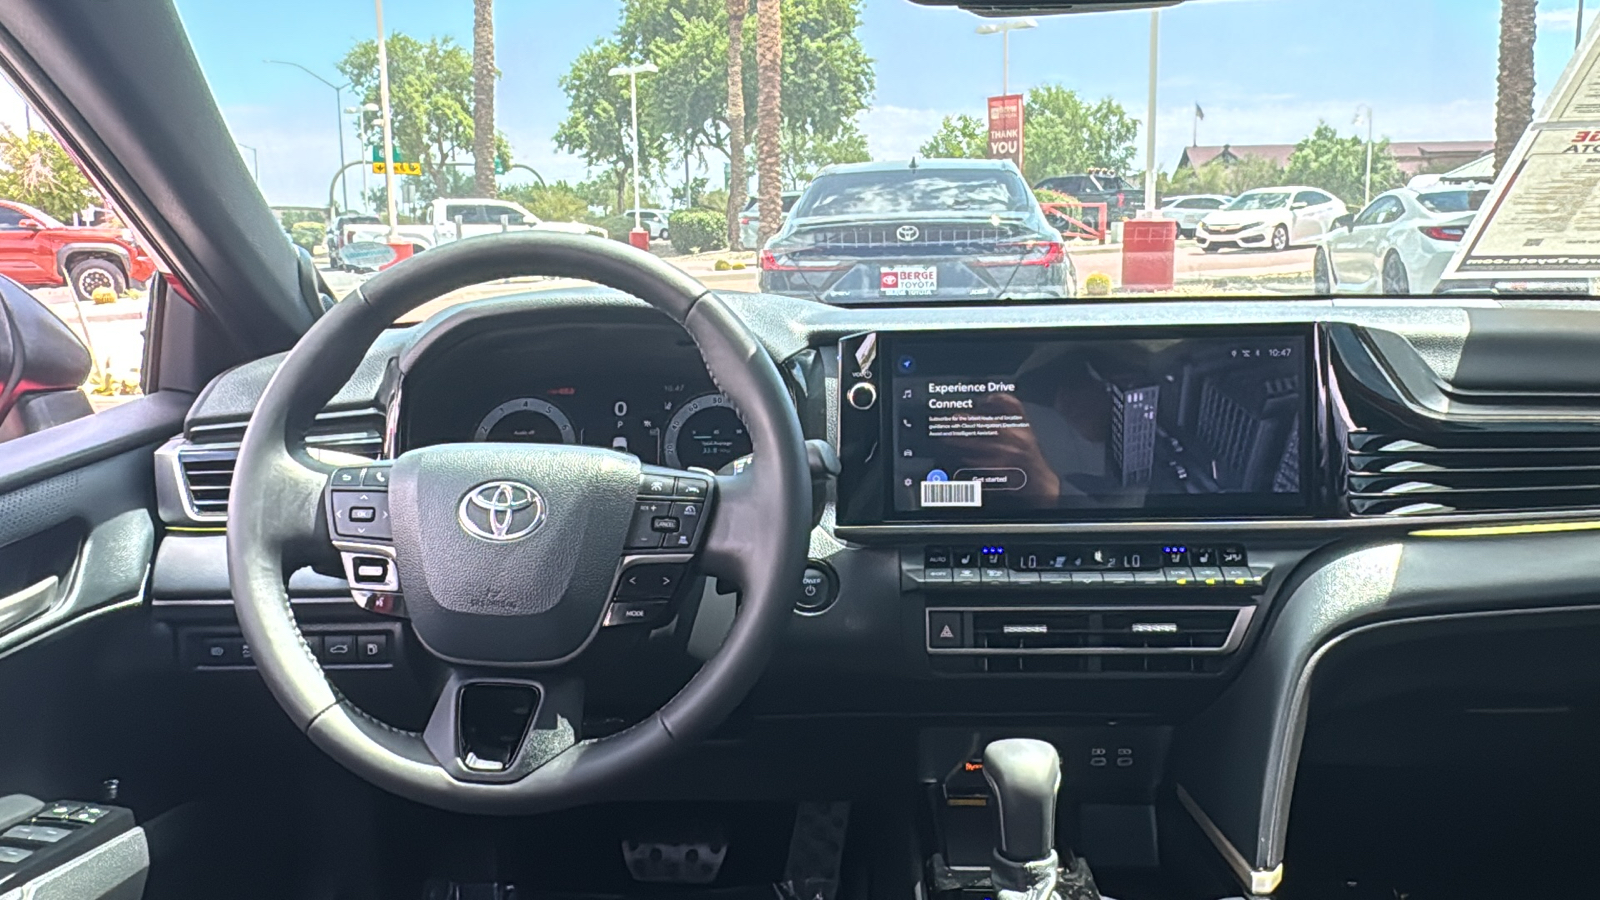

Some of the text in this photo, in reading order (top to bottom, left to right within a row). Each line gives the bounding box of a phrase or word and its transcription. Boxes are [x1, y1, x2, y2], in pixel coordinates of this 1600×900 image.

[991, 129, 1018, 139] THANK
[991, 141, 1017, 154] YOU
[900, 271, 934, 280] BERGE
[1268, 348, 1291, 357] 10:47
[928, 381, 1015, 394] Experience Drive
[928, 398, 973, 409] Connect
[985, 475, 1007, 483] started
